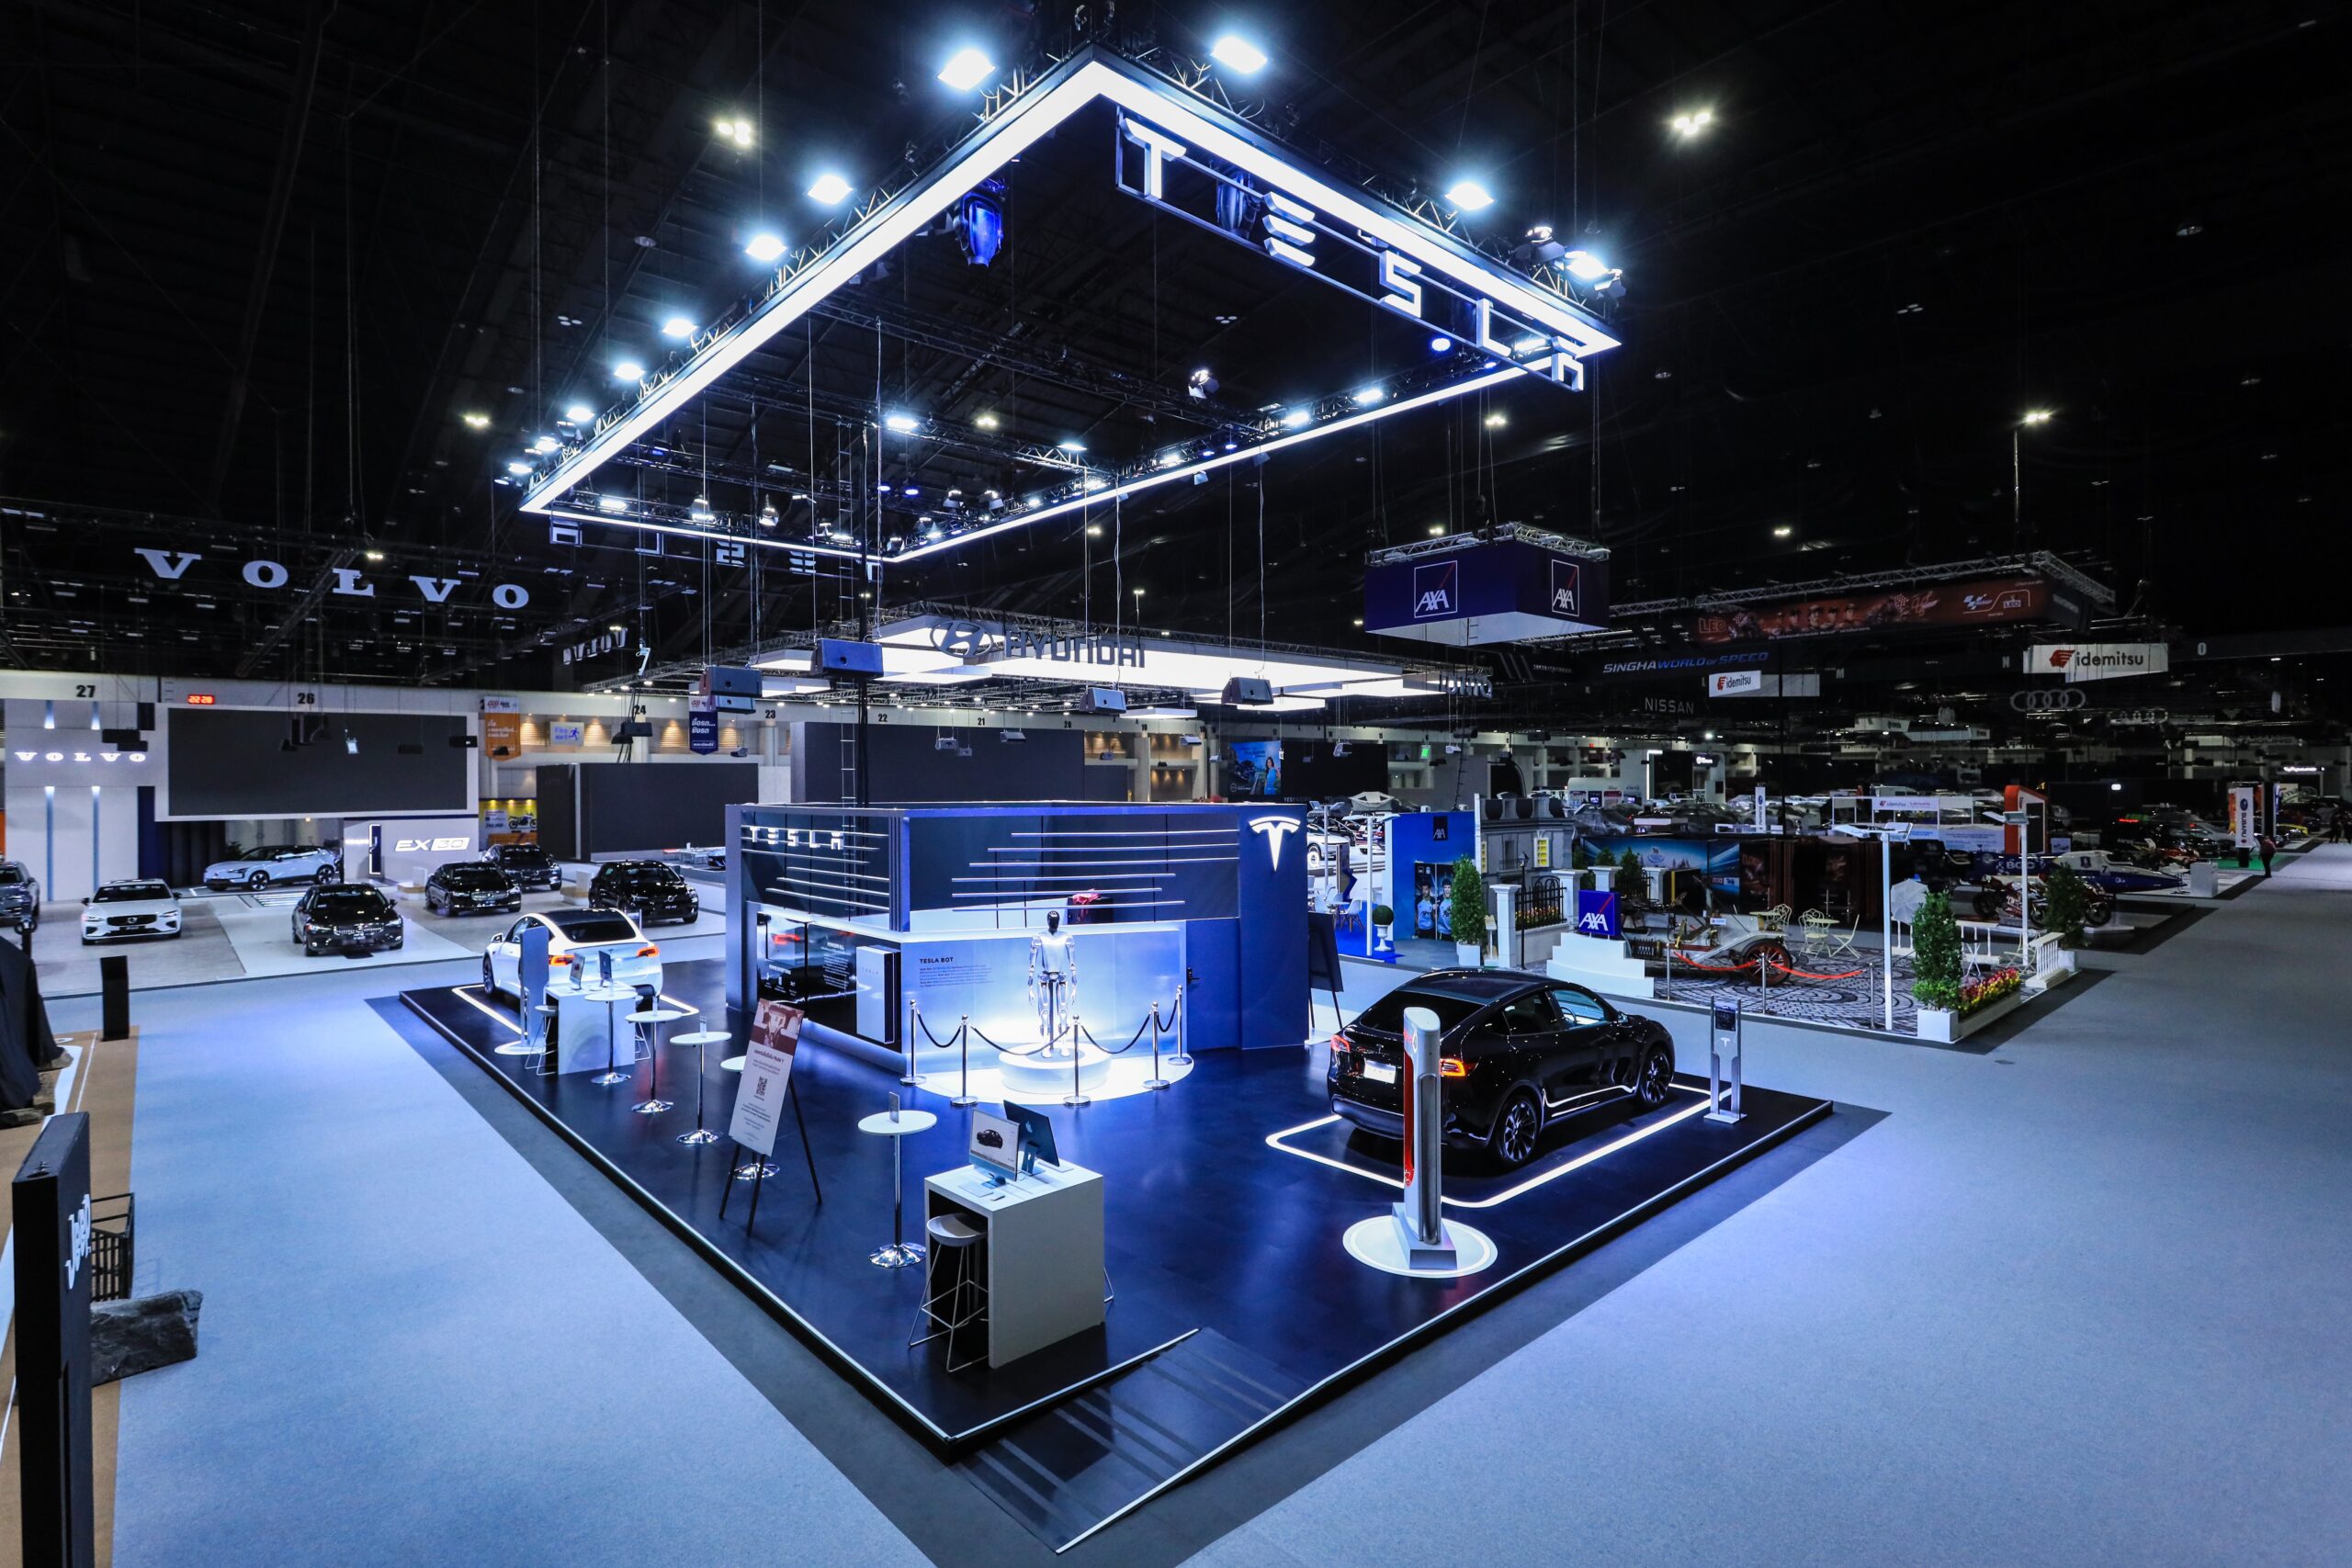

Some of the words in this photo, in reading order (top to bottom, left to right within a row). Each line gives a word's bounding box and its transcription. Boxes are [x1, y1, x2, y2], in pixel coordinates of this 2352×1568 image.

[1119, 118, 1584, 391] TESLA
[134, 547, 530, 609] VOLVO
[1415, 589, 1450, 613] AXA
[1553, 588, 1575, 611] AXA
[1006, 630, 1146, 669] HYUNDAI
[1718, 652, 1770, 665] SPEED
[2076, 651, 2143, 667] idemitsu
[1725, 674, 1752, 689] idemitsu
[76, 684, 96, 698] 27
[297, 693, 315, 705] 26
[634, 705, 646, 715] 24
[764, 709, 775, 719] 23
[1645, 697, 1695, 715] NISSAN
[877, 713, 888, 723] 22
[977, 717, 986, 726] 21
[15, 752, 147, 763] VOLVO
[749, 826, 844, 851] TESLA
[1578, 912, 1609, 931] AXA
[65, 1193, 92, 1291] Jeep
